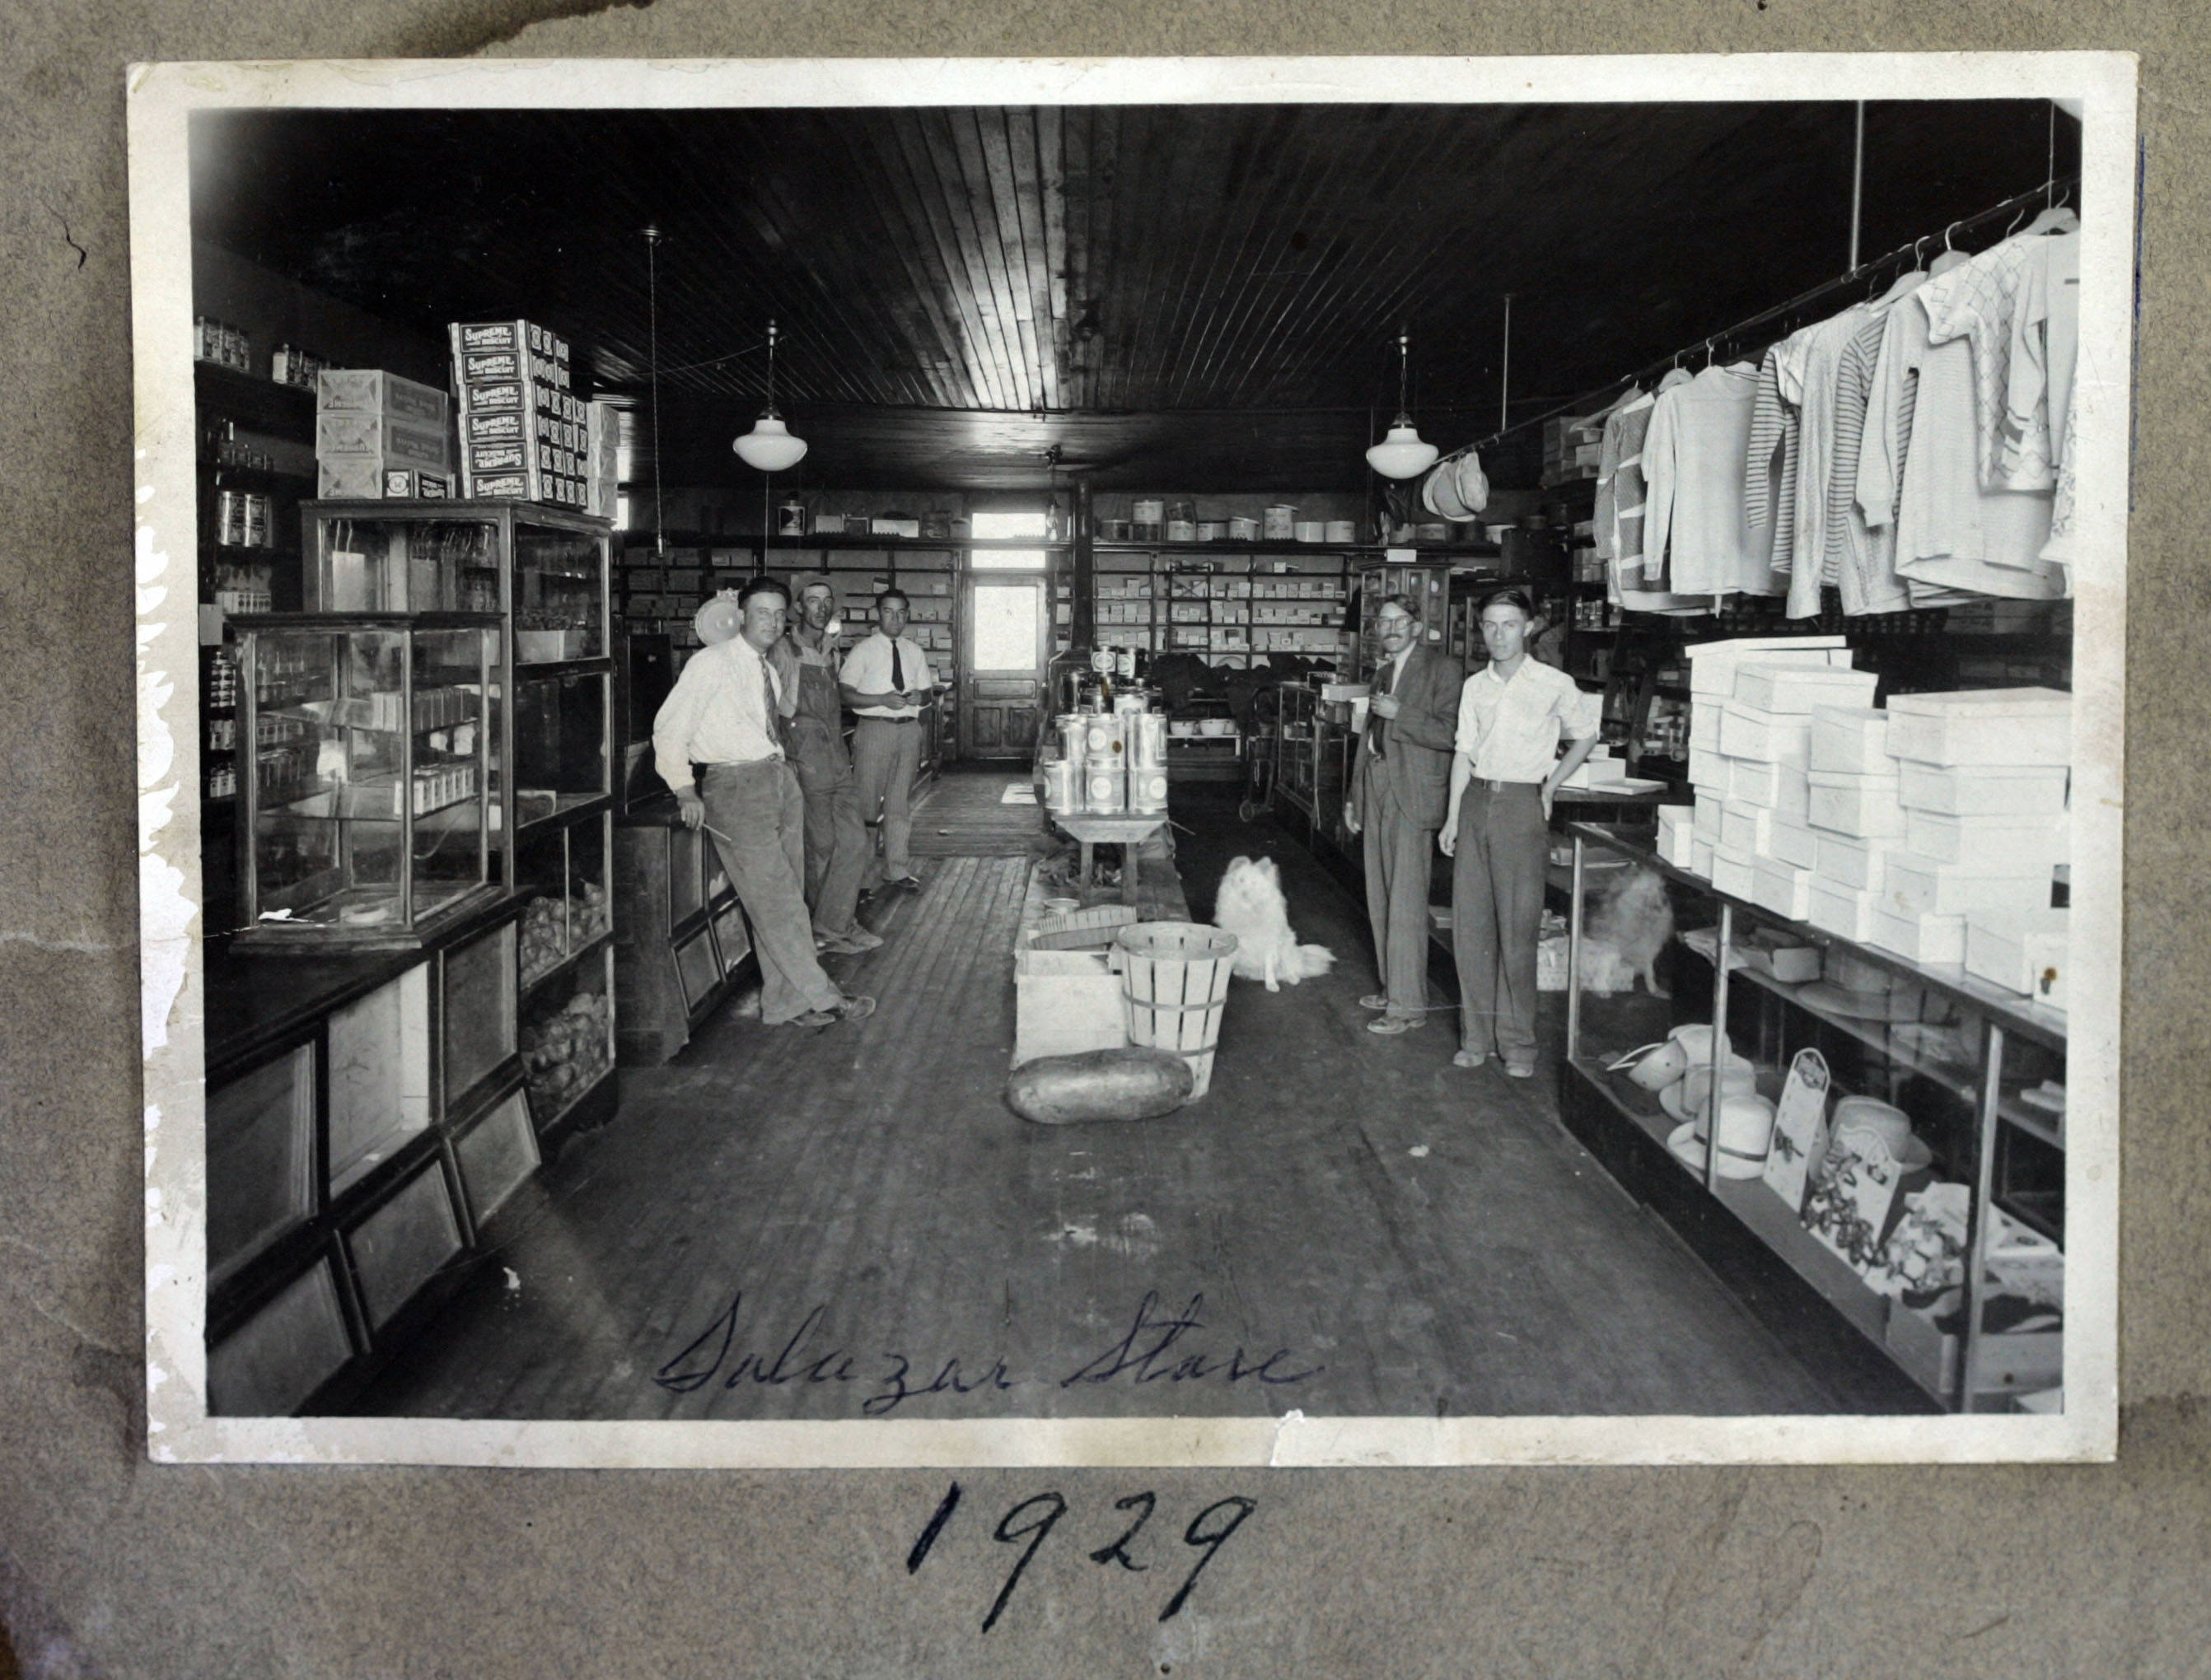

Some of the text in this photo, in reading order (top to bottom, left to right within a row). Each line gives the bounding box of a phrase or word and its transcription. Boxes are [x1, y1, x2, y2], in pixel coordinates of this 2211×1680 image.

[465, 326, 512, 342] SUPREME
[468, 355, 515, 370] SUPREME
[472, 385, 519, 400] SUPREME
[472, 415, 520, 430] SUPREME
[476, 477, 524, 491] SUPREME
[652, 1290, 1018, 1415] Salazar
[907, 1482, 1257, 1635] 1929
